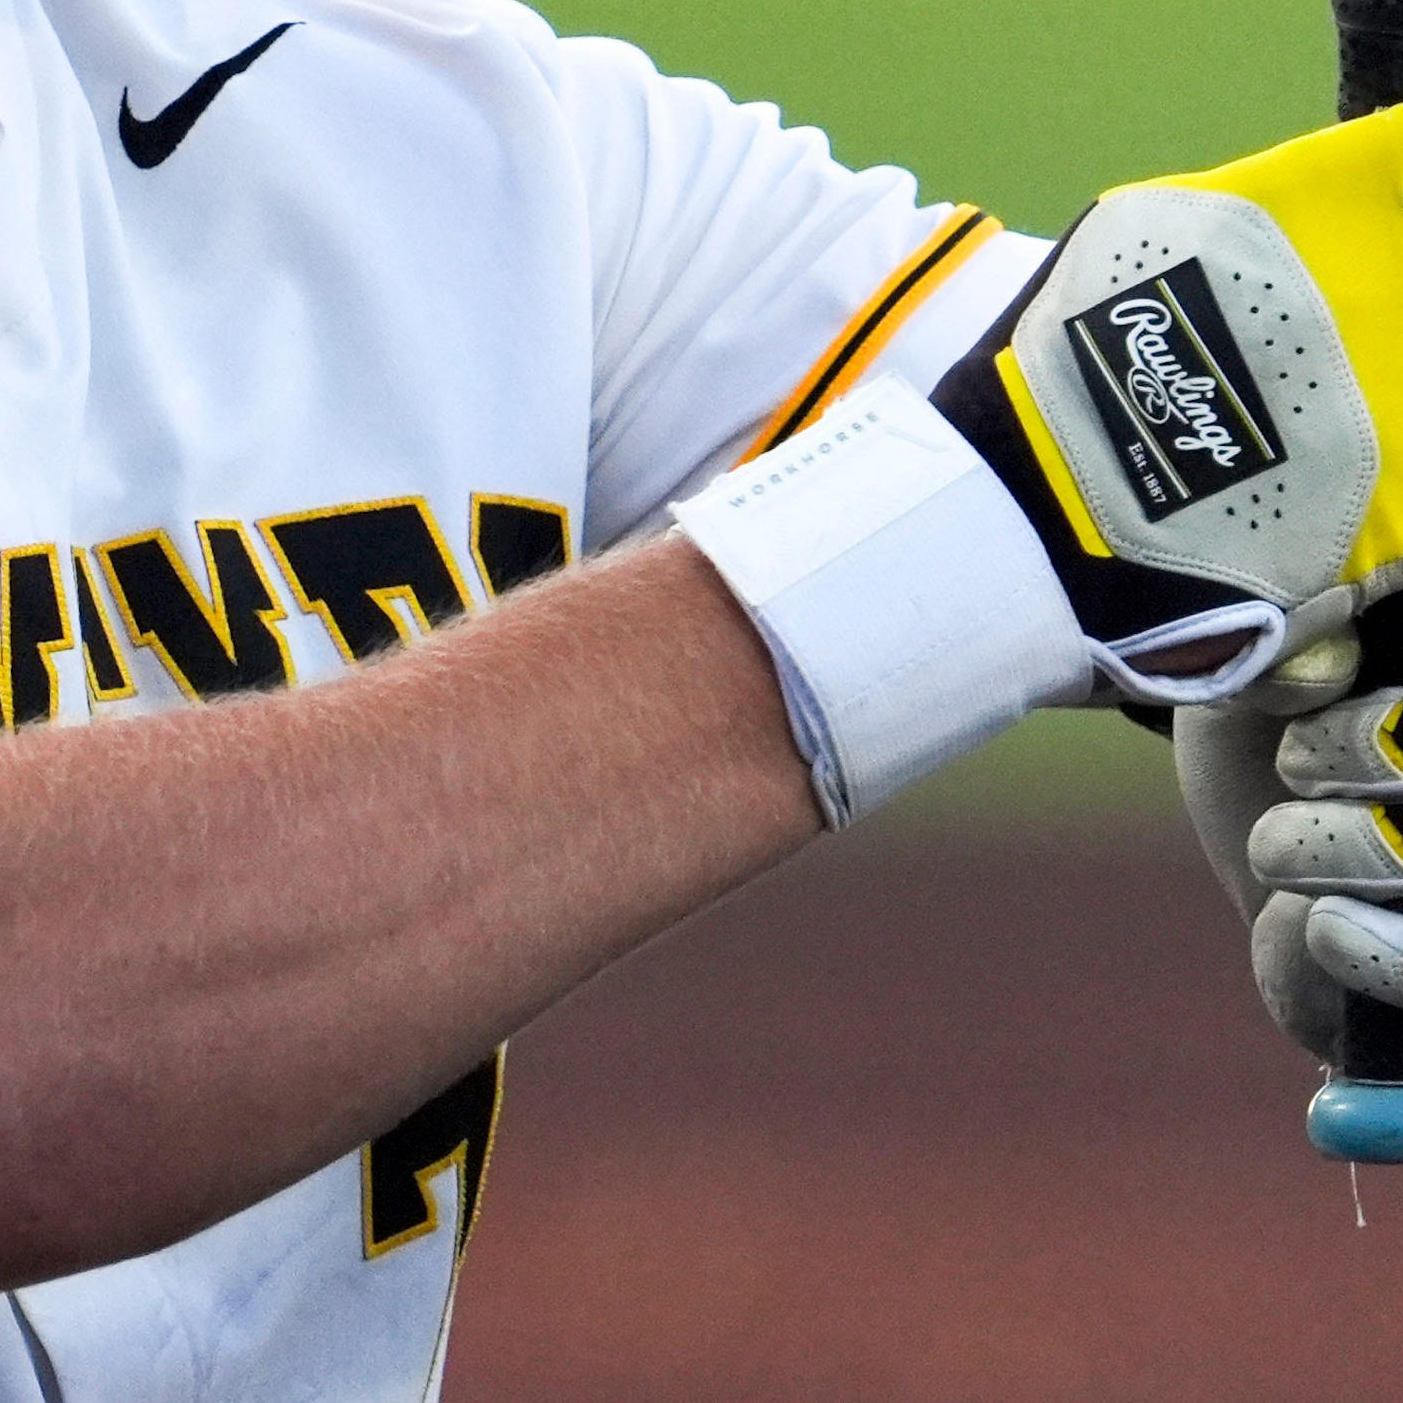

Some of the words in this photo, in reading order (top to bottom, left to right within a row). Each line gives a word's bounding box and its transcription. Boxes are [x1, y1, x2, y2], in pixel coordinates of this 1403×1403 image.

[1110, 298, 1242, 467] Rawlings
[729, 411, 879, 507] WORKHORSE
[1142, 472, 1167, 504] 1887
